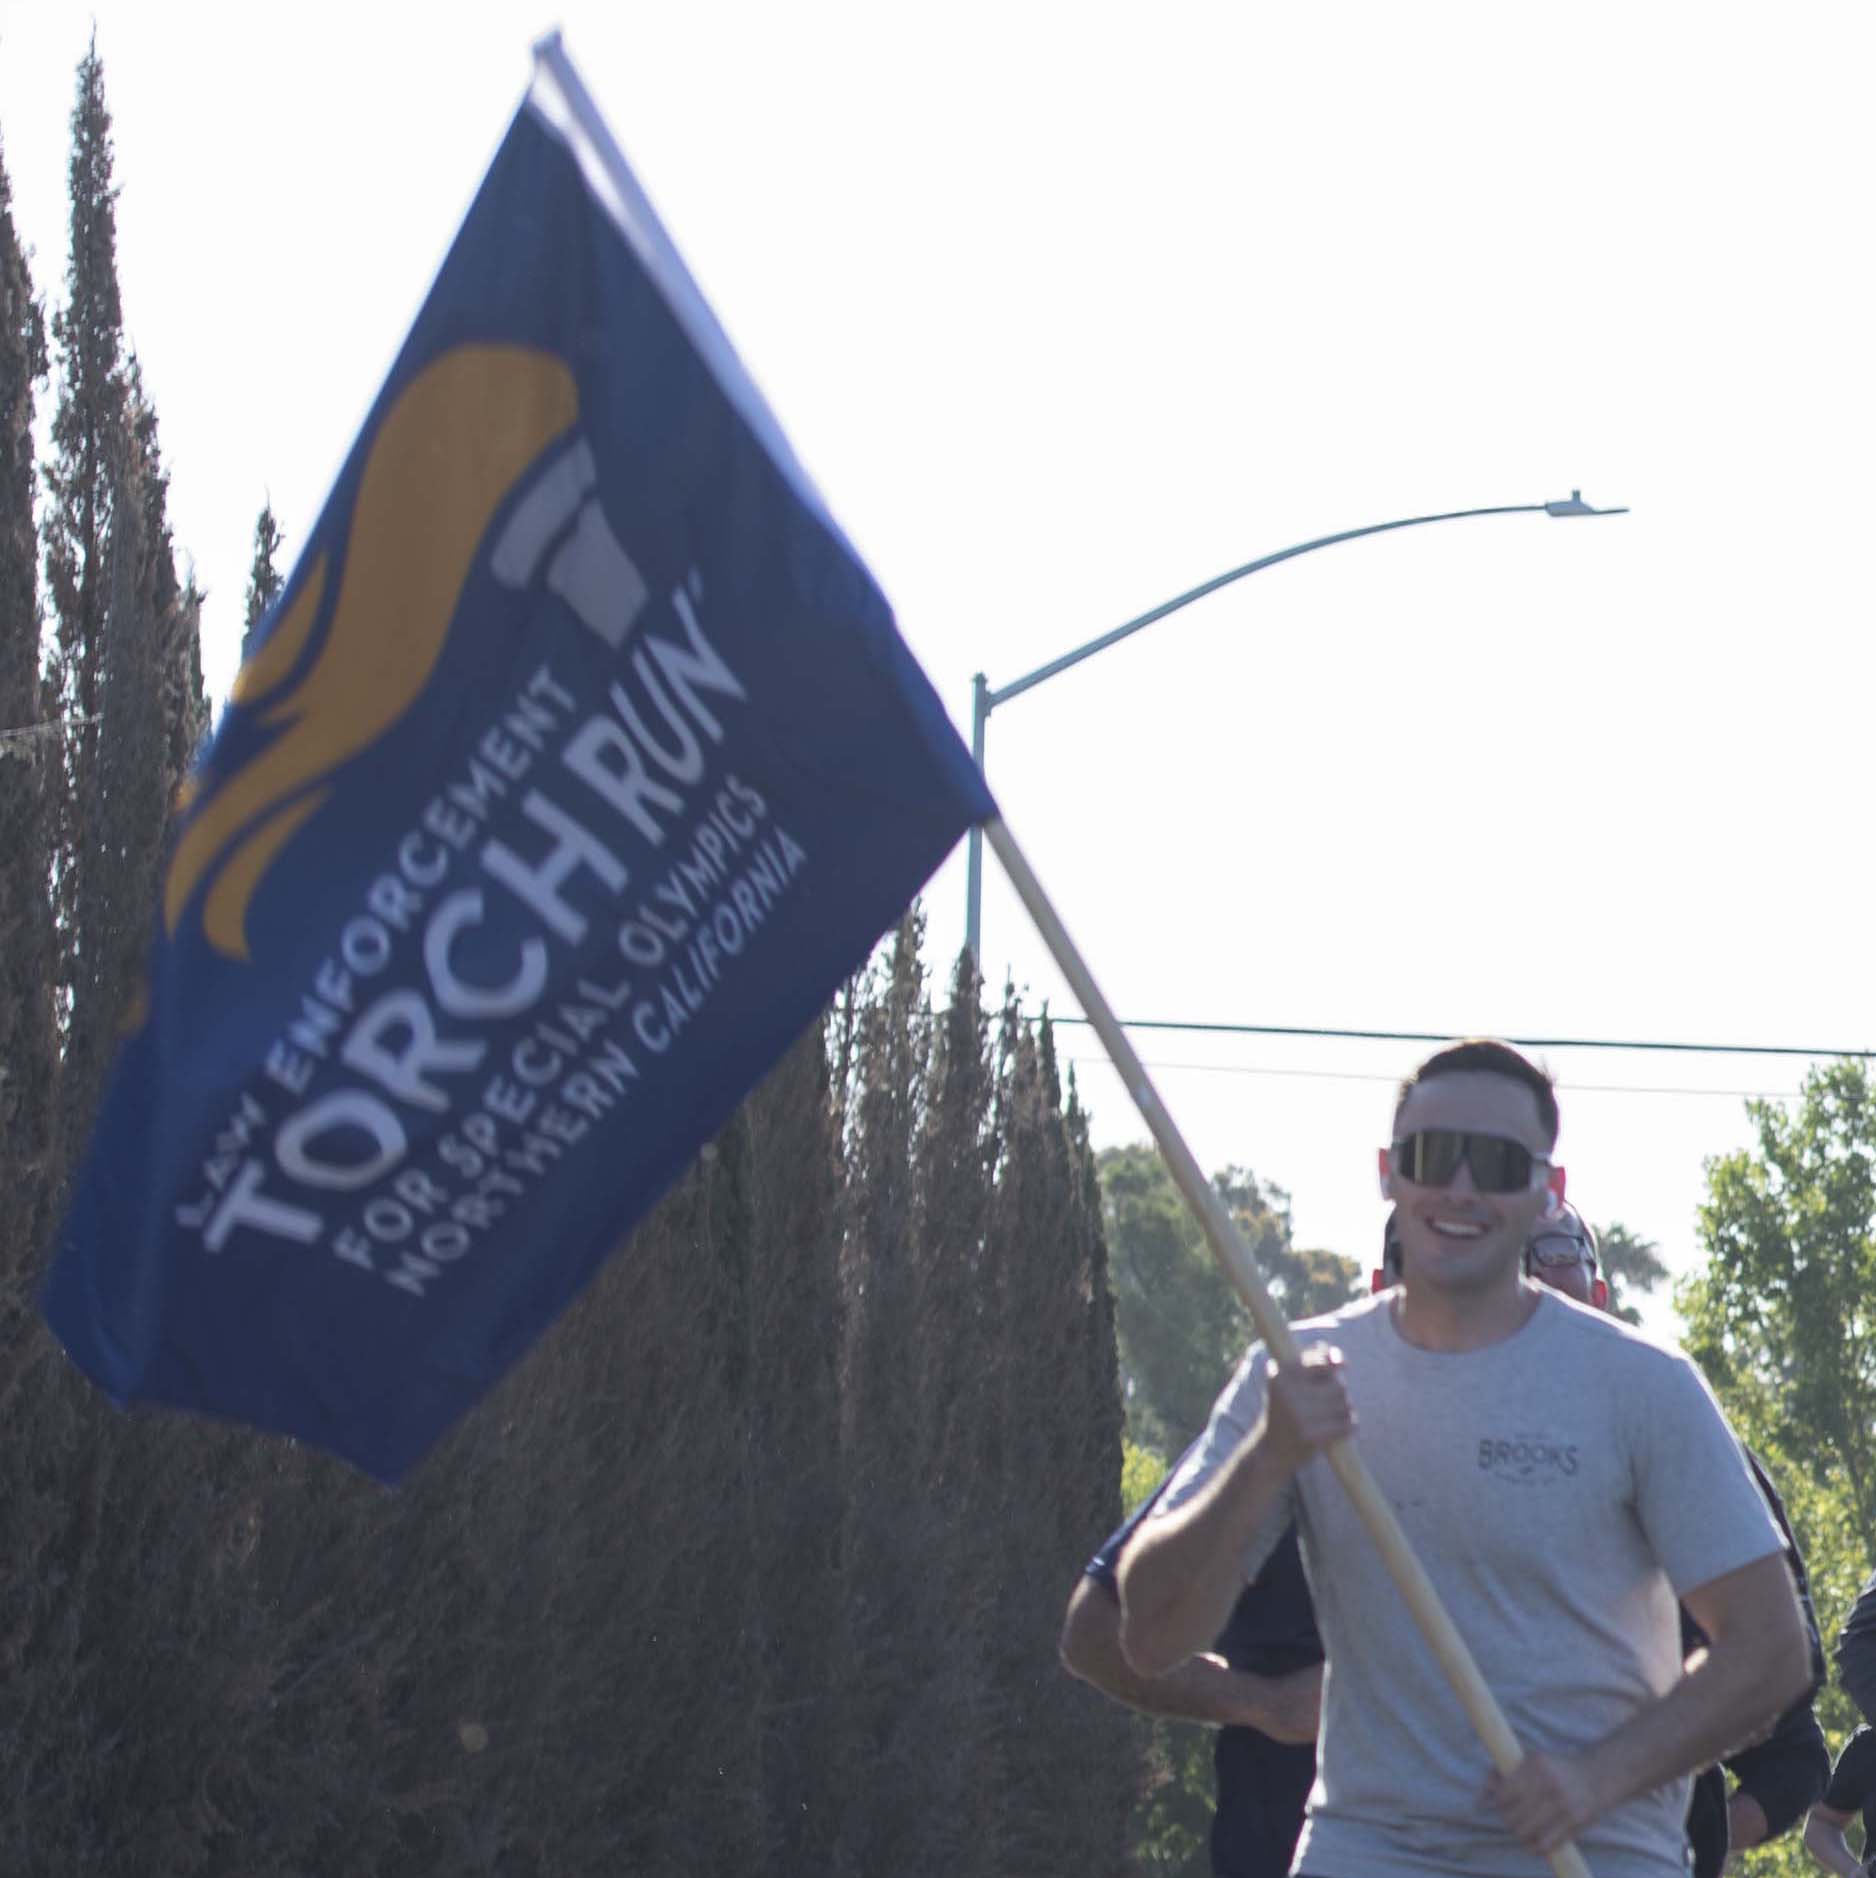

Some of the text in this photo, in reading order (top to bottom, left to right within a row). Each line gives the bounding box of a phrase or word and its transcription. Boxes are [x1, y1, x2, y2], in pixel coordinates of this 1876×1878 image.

[203, 586, 748, 1253] TORCH RUN
[265, 662, 576, 1095] ENFORCEMENT
[332, 772, 768, 1270] FOR SPECIAL OLYMPICS
[385, 827, 806, 1297] NORTHERN CALIFORNIA
[1478, 1438, 1578, 1477] BROOKS
